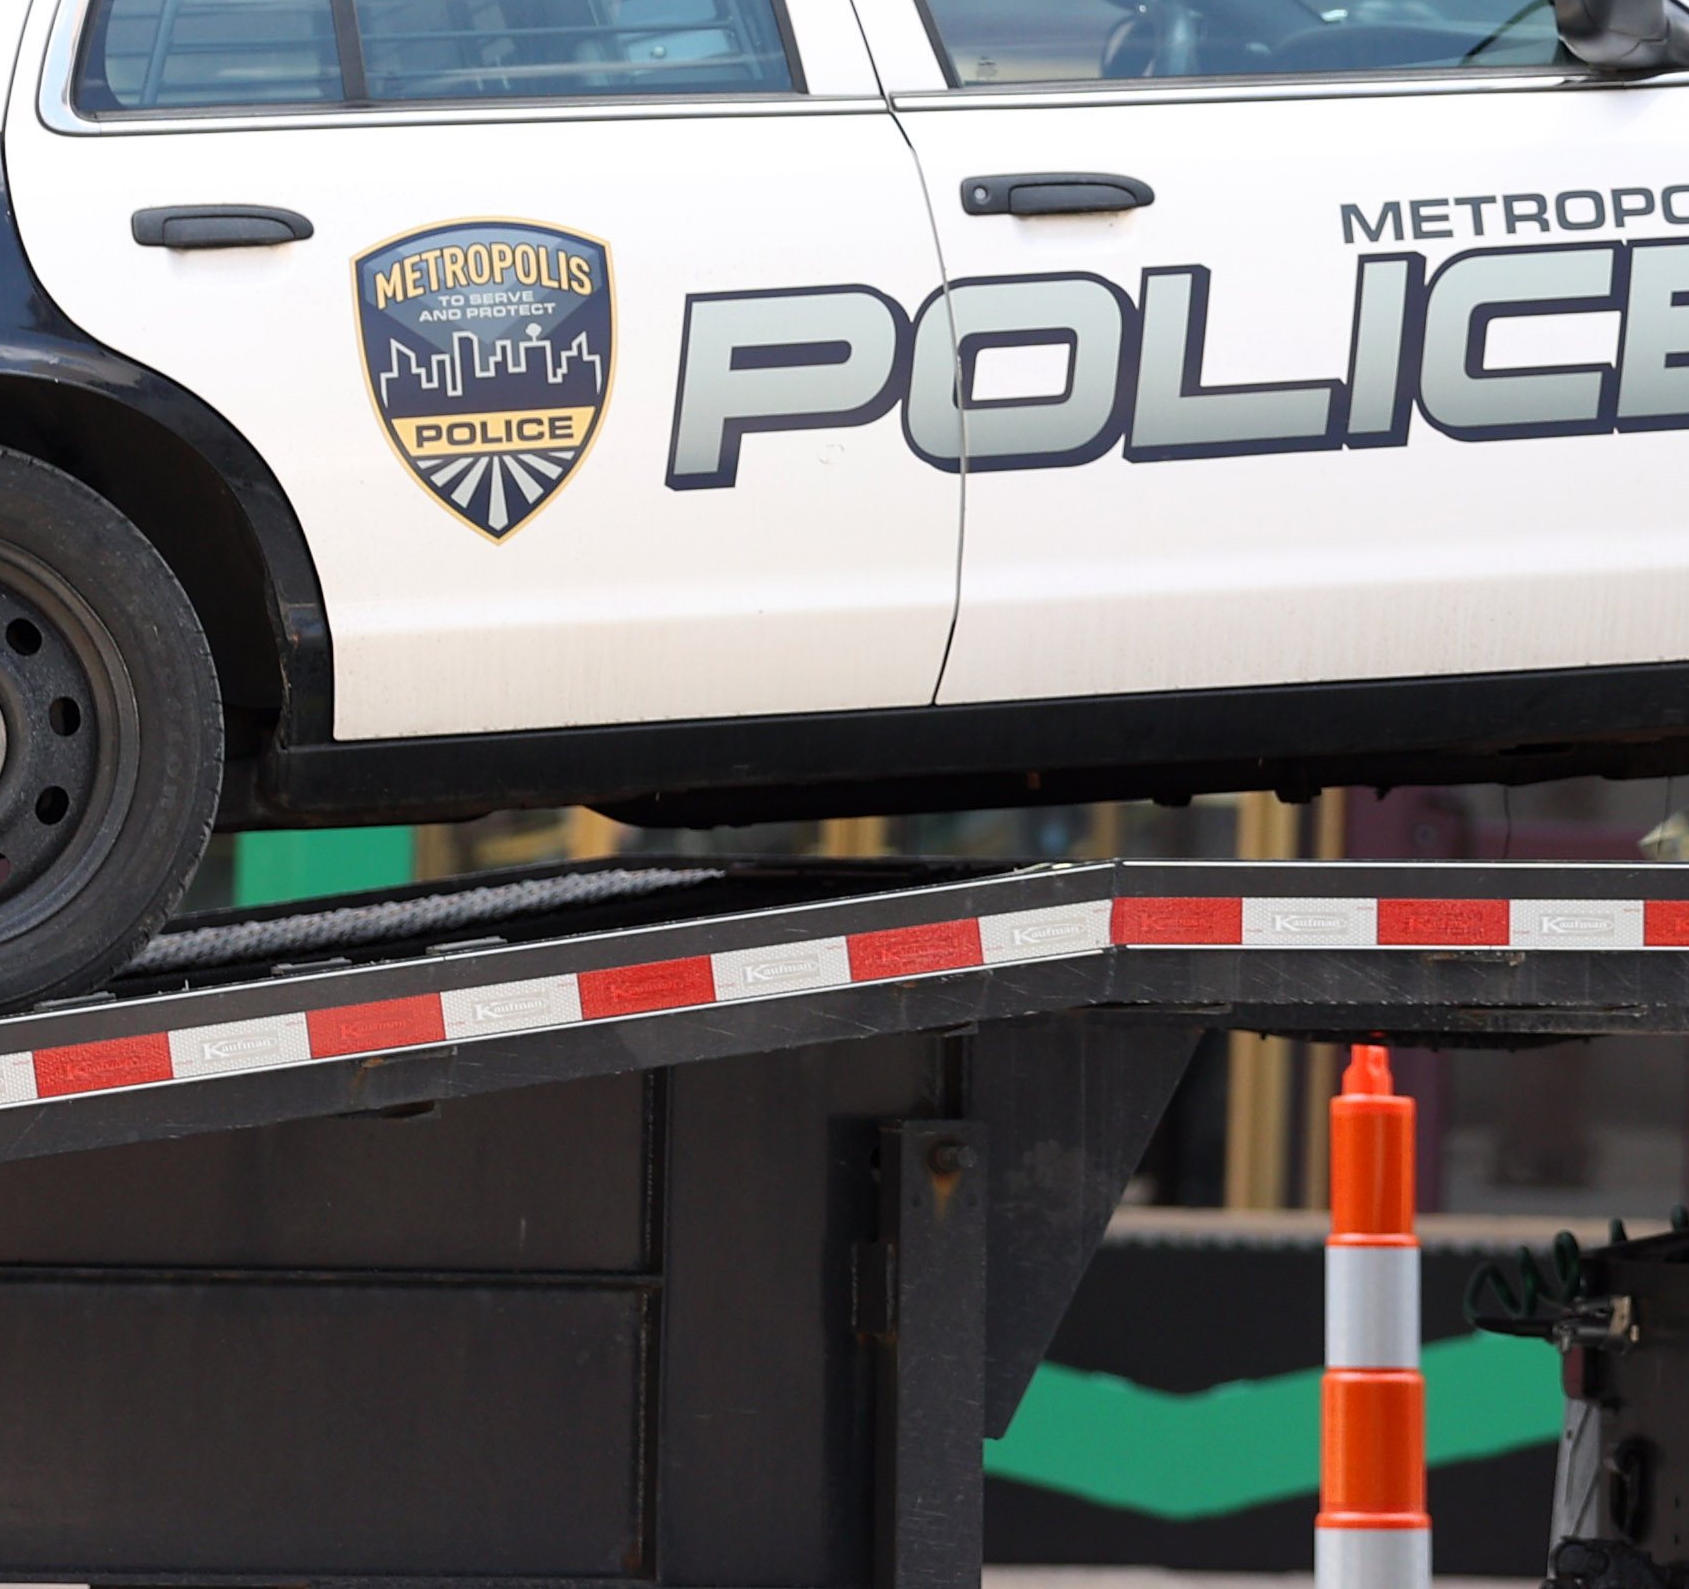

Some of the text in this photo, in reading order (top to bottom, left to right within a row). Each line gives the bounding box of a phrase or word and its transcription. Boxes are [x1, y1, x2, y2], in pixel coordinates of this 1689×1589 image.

[375, 242, 593, 310] METROPOLIS
[438, 290, 534, 307] TO SERVE
[419, 302, 556, 322] AND PROTECT
[416, 416, 574, 448] POLICE
[1014, 921, 1080, 944] Kaufman
[1273, 914, 1342, 932] Kaufman
[1541, 916, 1609, 934] Kaufman
[744, 960, 812, 983] Kaufman
[473, 997, 544, 1021] Kaufman
[204, 1037, 273, 1060] Kaufman
